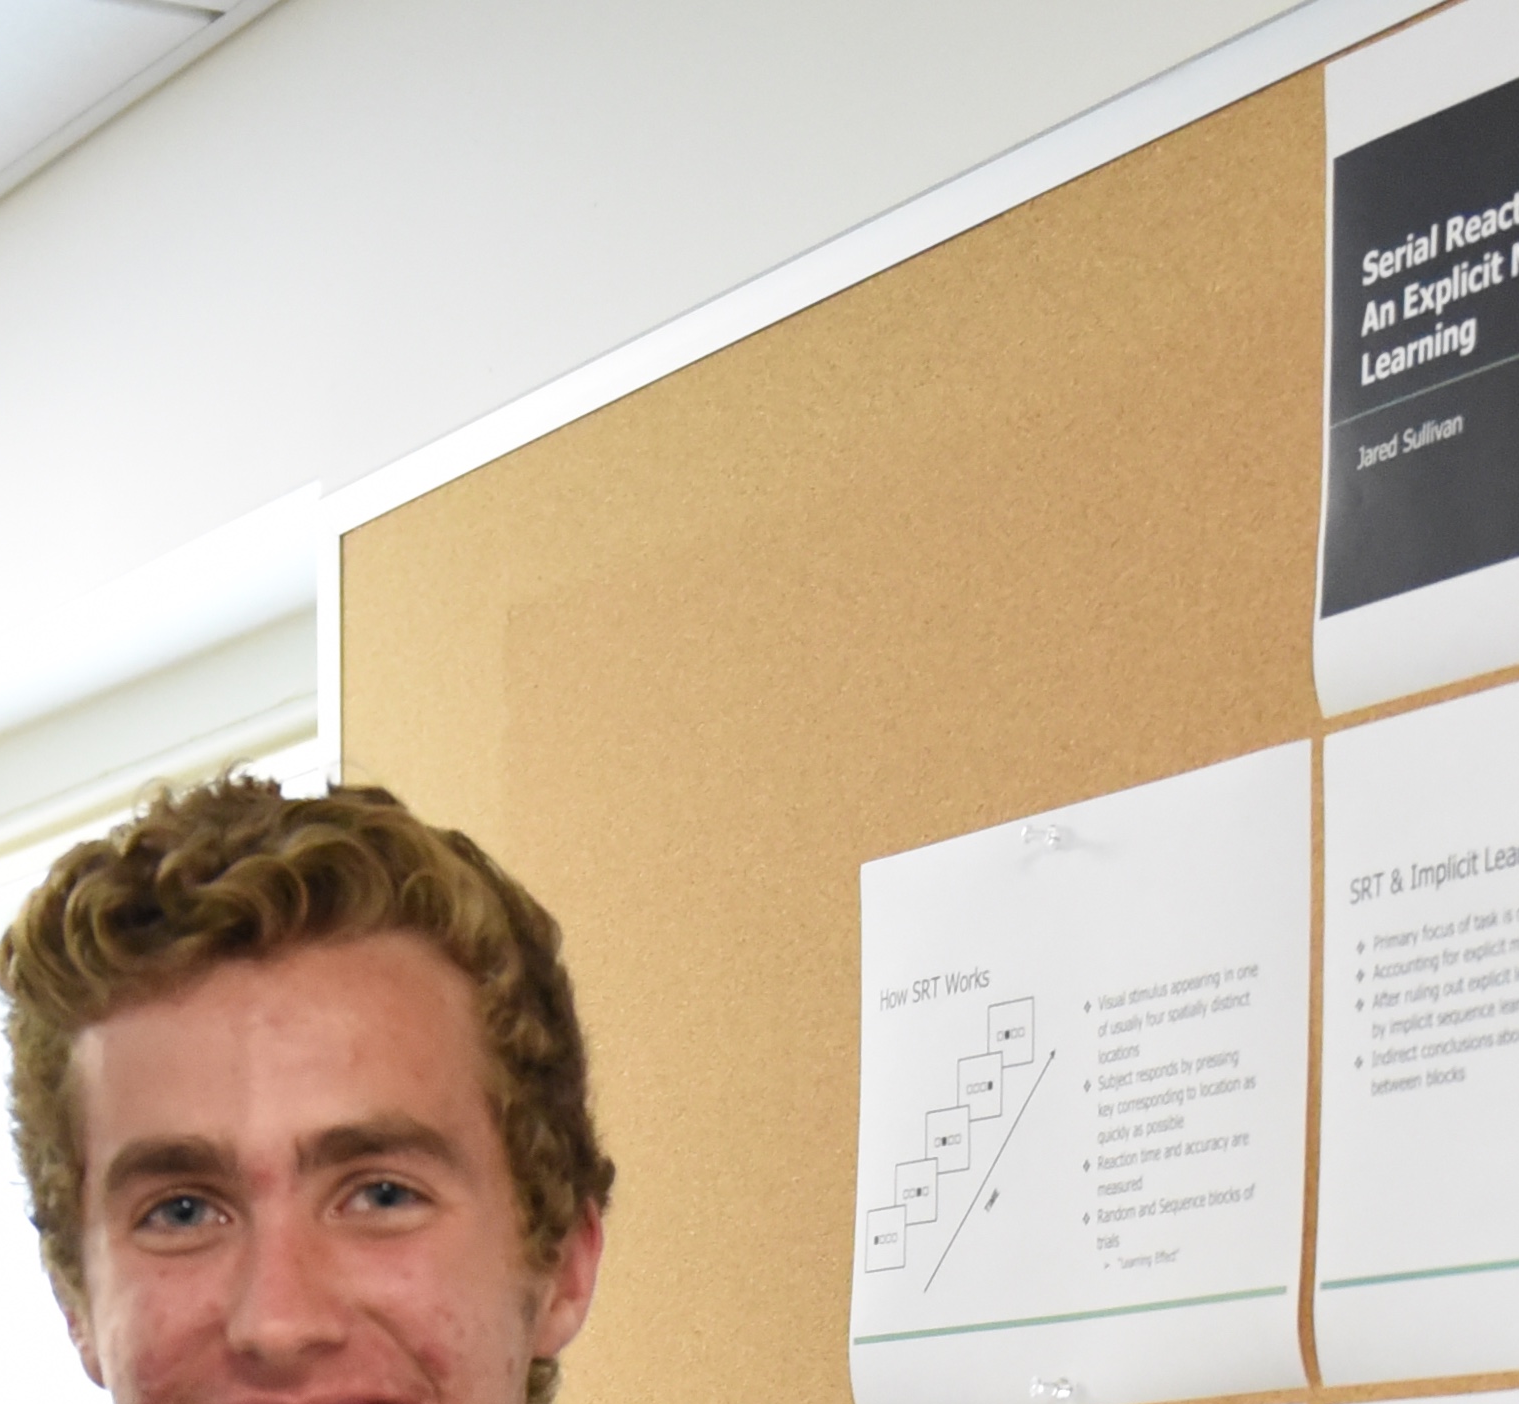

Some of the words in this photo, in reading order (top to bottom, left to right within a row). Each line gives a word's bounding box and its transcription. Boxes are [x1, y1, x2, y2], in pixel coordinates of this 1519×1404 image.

[1362, 225, 1439, 285] Serial
[1362, 300, 1396, 336] An
[1403, 253, 1503, 317] Explicit
[1361, 320, 1477, 384] Learning
[1357, 434, 1399, 470] Jared
[1403, 416, 1464, 452] Sullivan
[1350, 872, 1384, 905] SRT
[1390, 868, 1404, 895] &
[1411, 851, 1479, 890] Implicit
[1373, 931, 1419, 951] Primary
[1422, 922, 1455, 941] focus
[1457, 914, 1472, 935] of
[1473, 910, 1499, 931] task
[1502, 909, 1514, 925] is
[880, 989, 908, 1010] How
[912, 976, 940, 1003] SRT
[945, 967, 990, 994] Works
